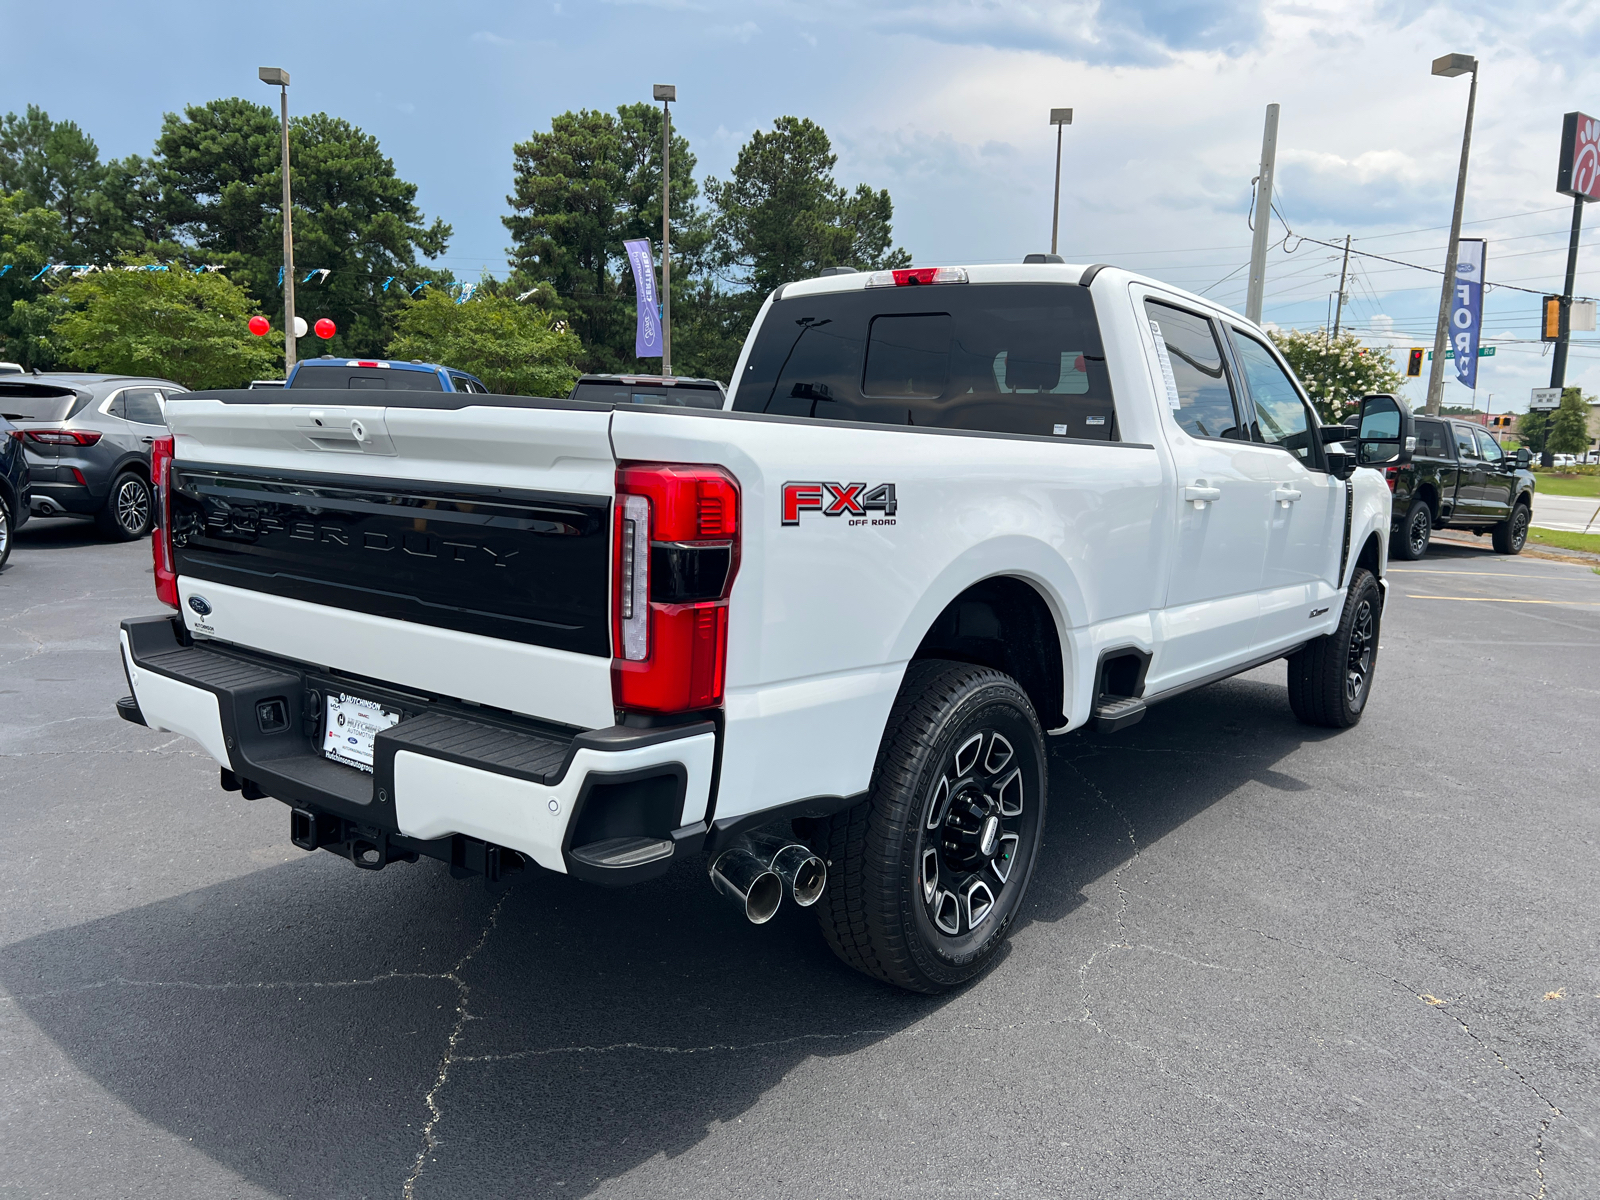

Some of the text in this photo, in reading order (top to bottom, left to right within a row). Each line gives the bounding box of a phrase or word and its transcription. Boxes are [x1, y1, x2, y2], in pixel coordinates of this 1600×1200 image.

[781, 480, 898, 527] FX4
[207, 510, 520, 567] SUPER DUTY
[345, 694, 382, 710] HUTCHINSON
